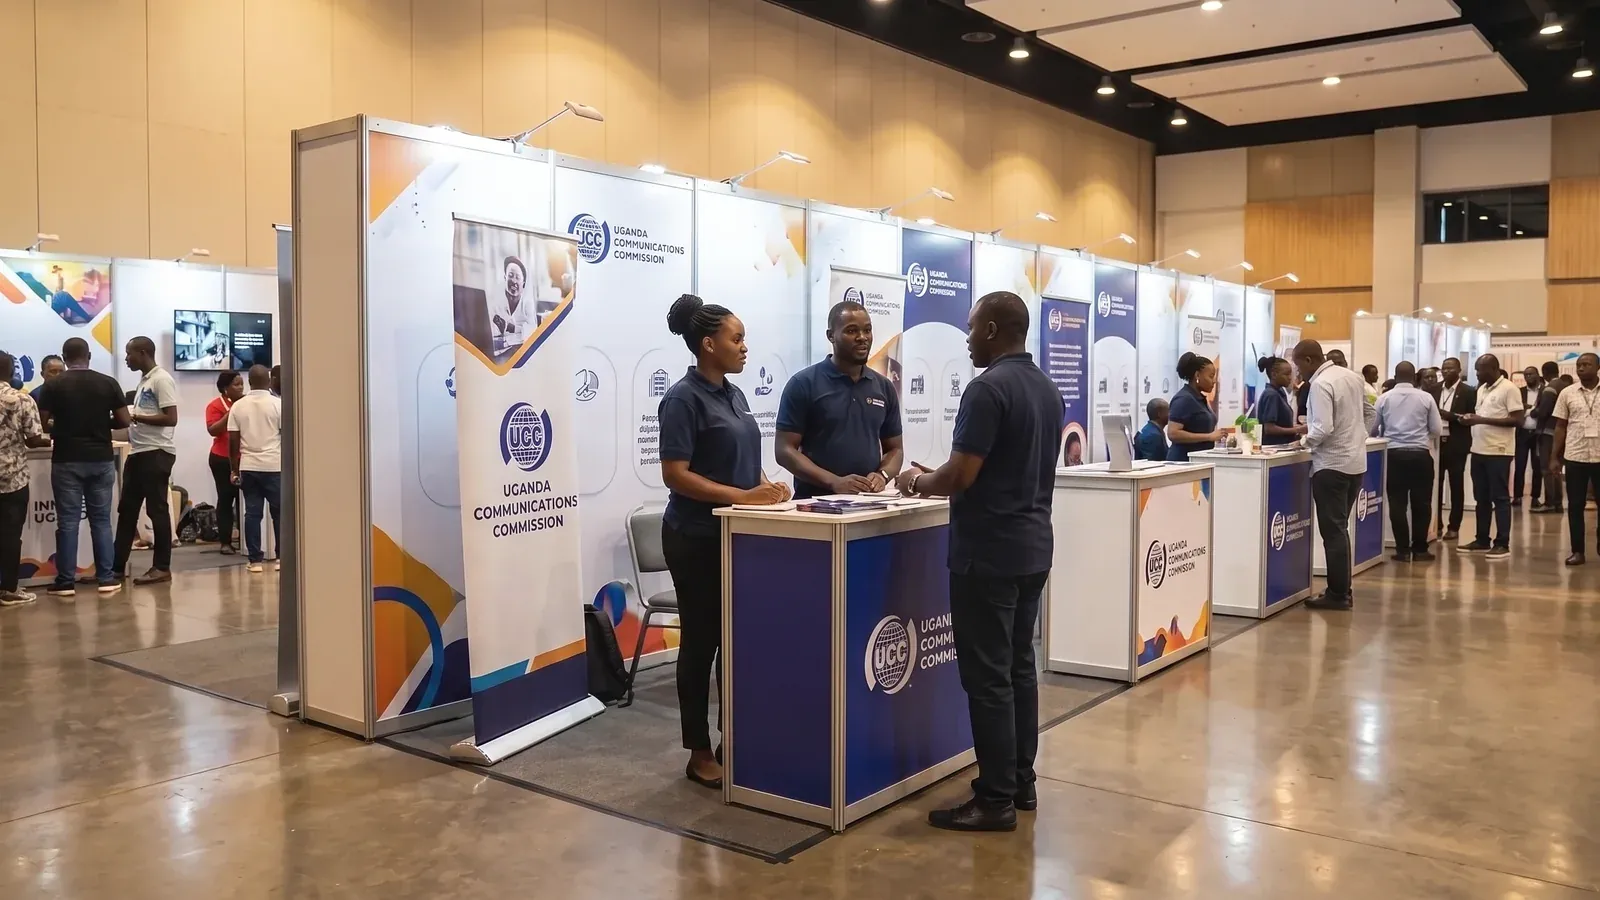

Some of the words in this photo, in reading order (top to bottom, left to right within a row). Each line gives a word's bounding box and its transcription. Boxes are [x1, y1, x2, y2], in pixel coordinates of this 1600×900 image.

[614, 226, 648, 238] UGANDA
[614, 238, 685, 255] COMMUNICATIONS
[614, 250, 665, 264] COMMISSION
[509, 425, 543, 448] UCC
[503, 480, 552, 497] UGANDA
[473, 495, 578, 521] COMMUNICATIONS
[493, 515, 564, 538] COMMISSION
[921, 612, 952, 633] UGAN
[875, 640, 907, 670] UCC
